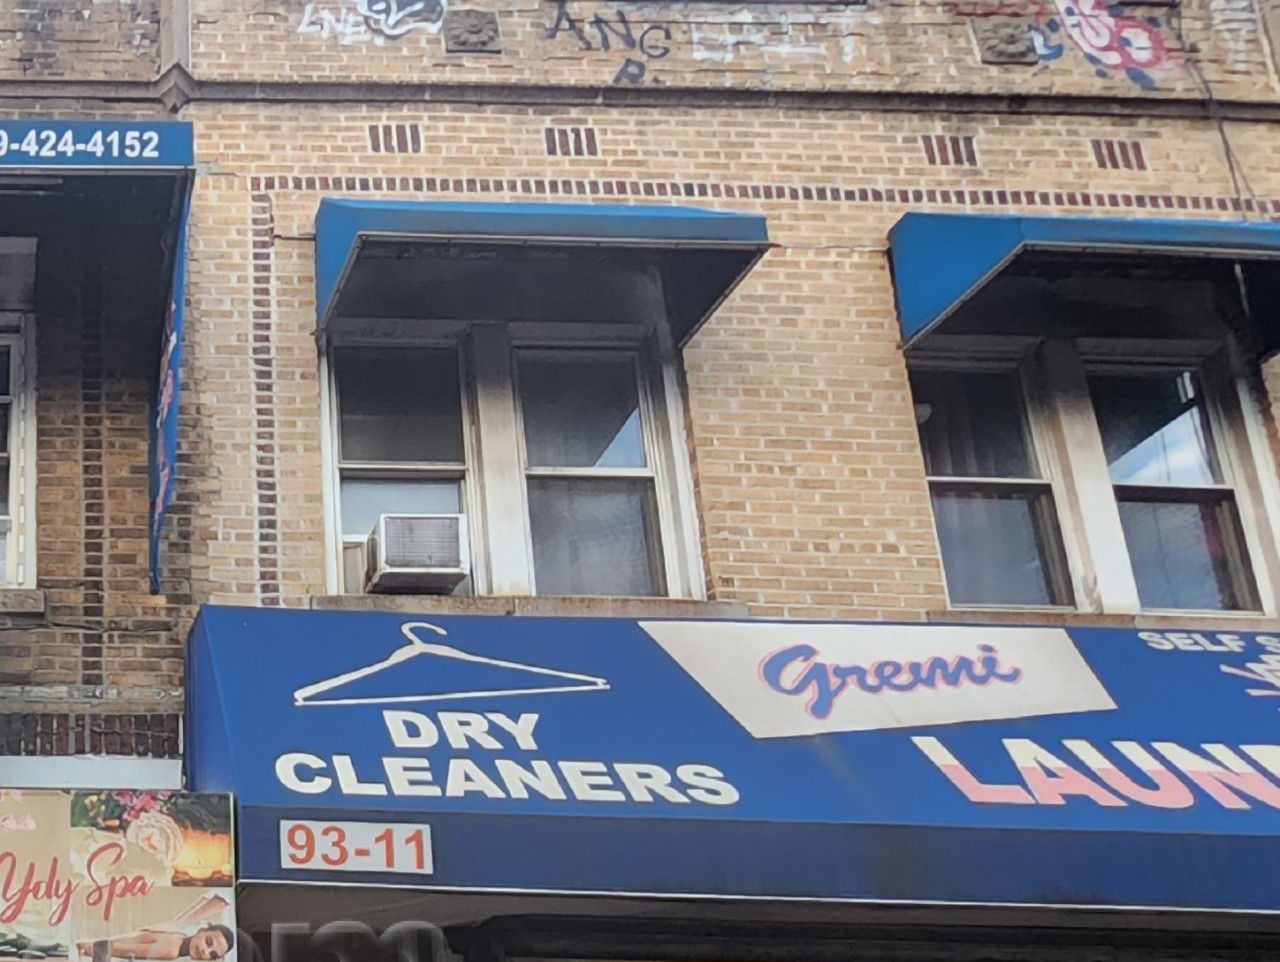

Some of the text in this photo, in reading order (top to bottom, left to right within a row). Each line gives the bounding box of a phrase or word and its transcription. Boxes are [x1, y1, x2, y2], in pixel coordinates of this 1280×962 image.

[1137, 631, 1246, 653] SELF
[757, 643, 1023, 720] Gremi
[382, 709, 540, 751] DRY
[274, 752, 741, 806] CLEANERS
[286, 823, 426, 870] 93-11
[85, 842, 155, 922] Spa
